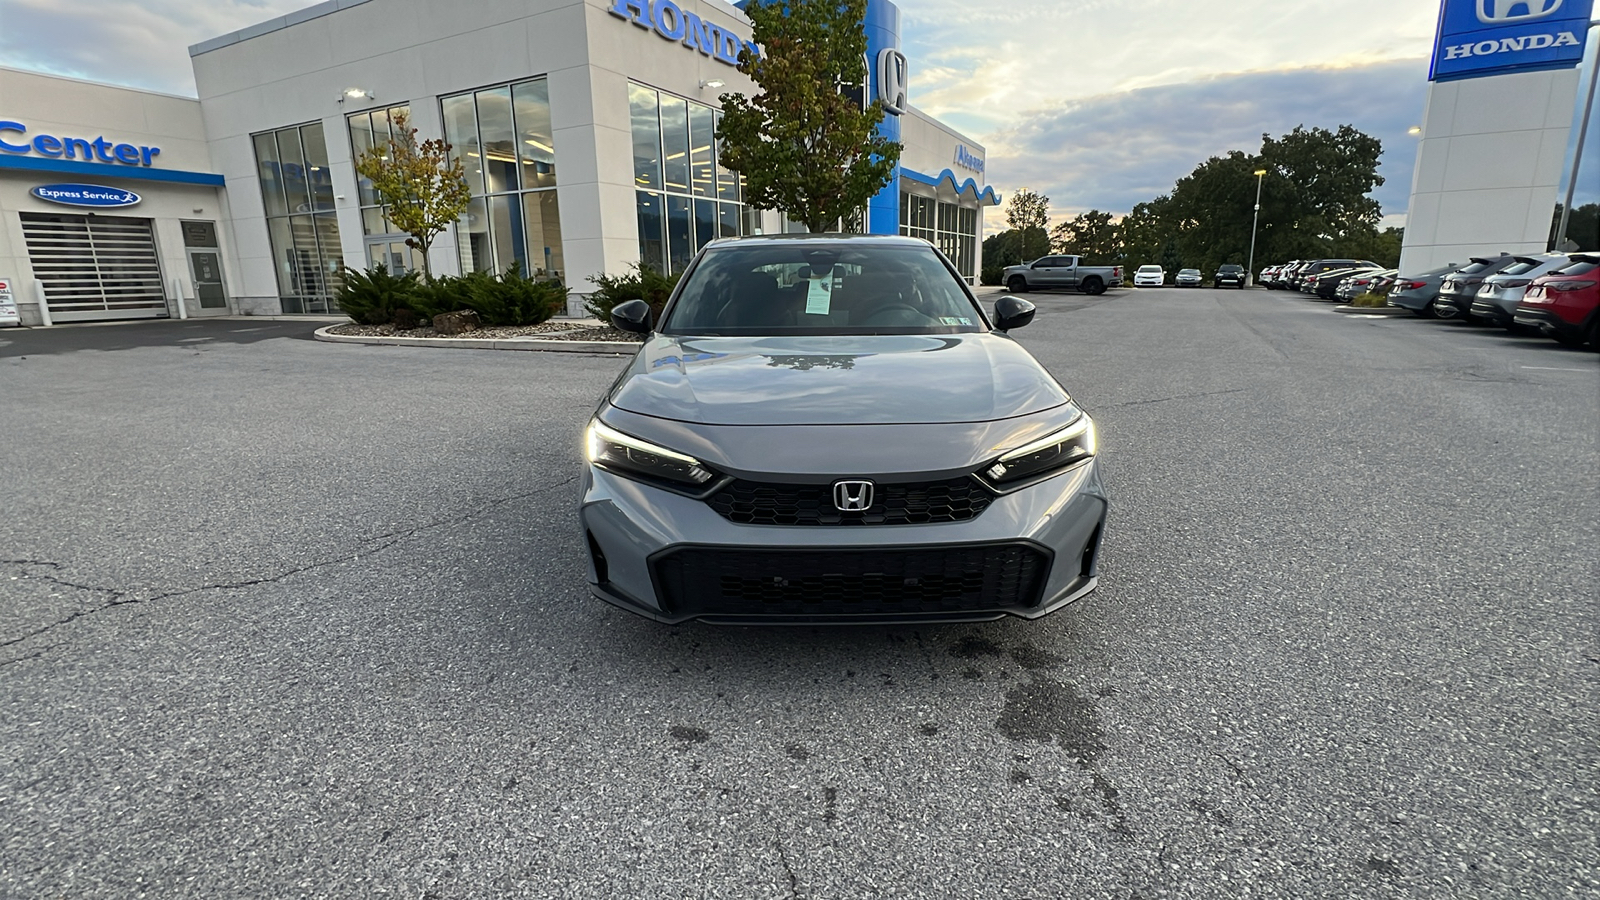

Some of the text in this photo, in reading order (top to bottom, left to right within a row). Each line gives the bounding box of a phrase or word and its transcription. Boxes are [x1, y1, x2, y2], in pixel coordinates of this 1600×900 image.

[1444, 31, 1581, 60] HONDA
[0, 120, 160, 166] Center
[39, 188, 120, 200] Express Service
